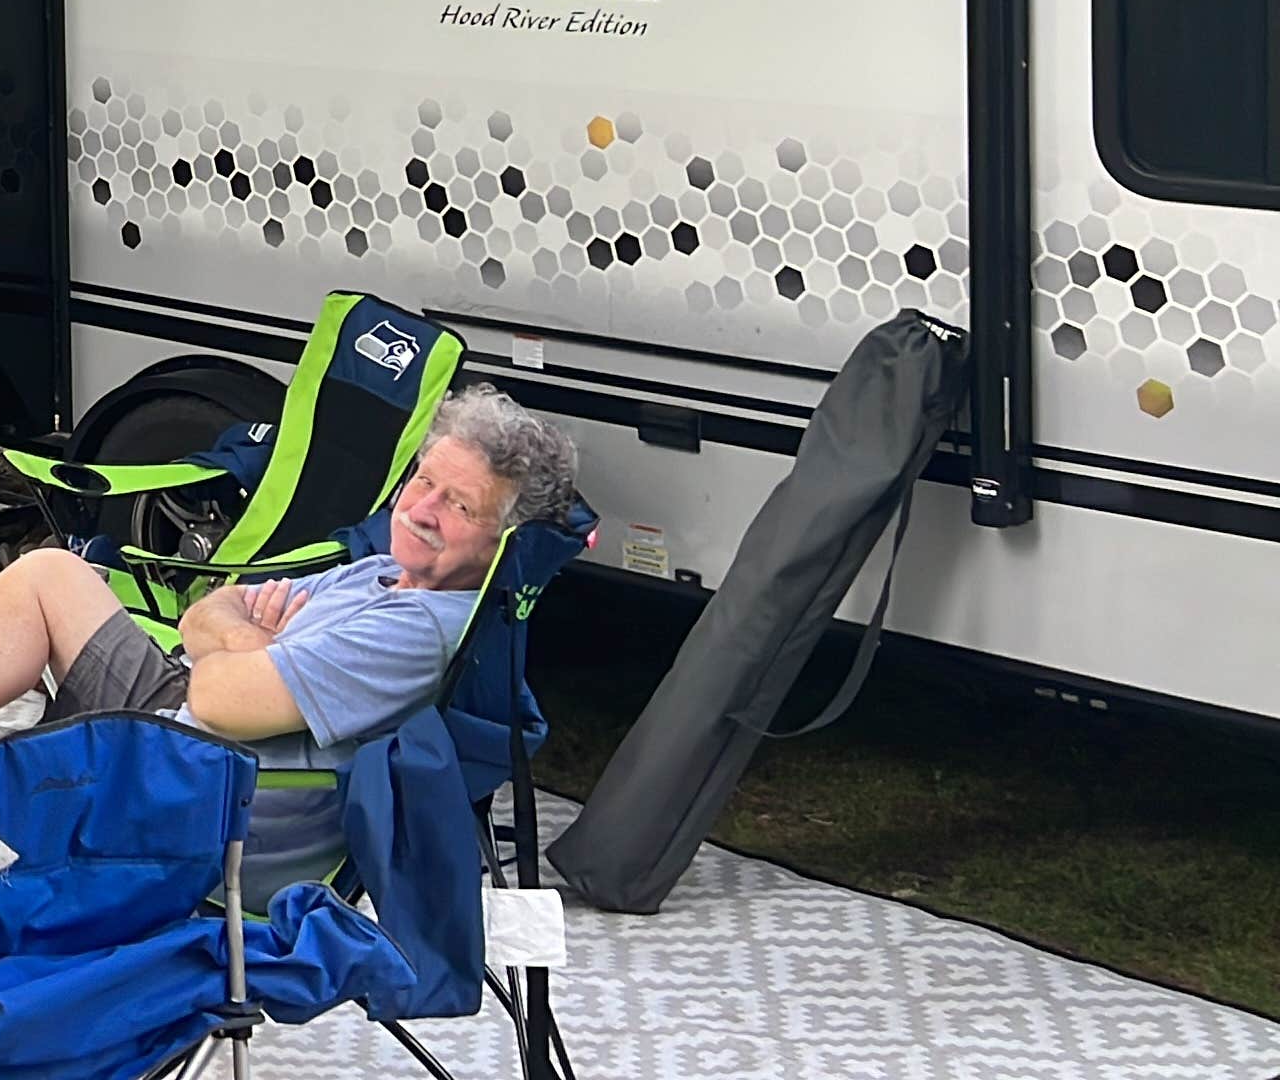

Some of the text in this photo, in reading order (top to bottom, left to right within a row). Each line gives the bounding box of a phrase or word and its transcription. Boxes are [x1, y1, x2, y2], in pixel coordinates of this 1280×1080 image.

[440, 3, 648, 36] Hood River Edition
